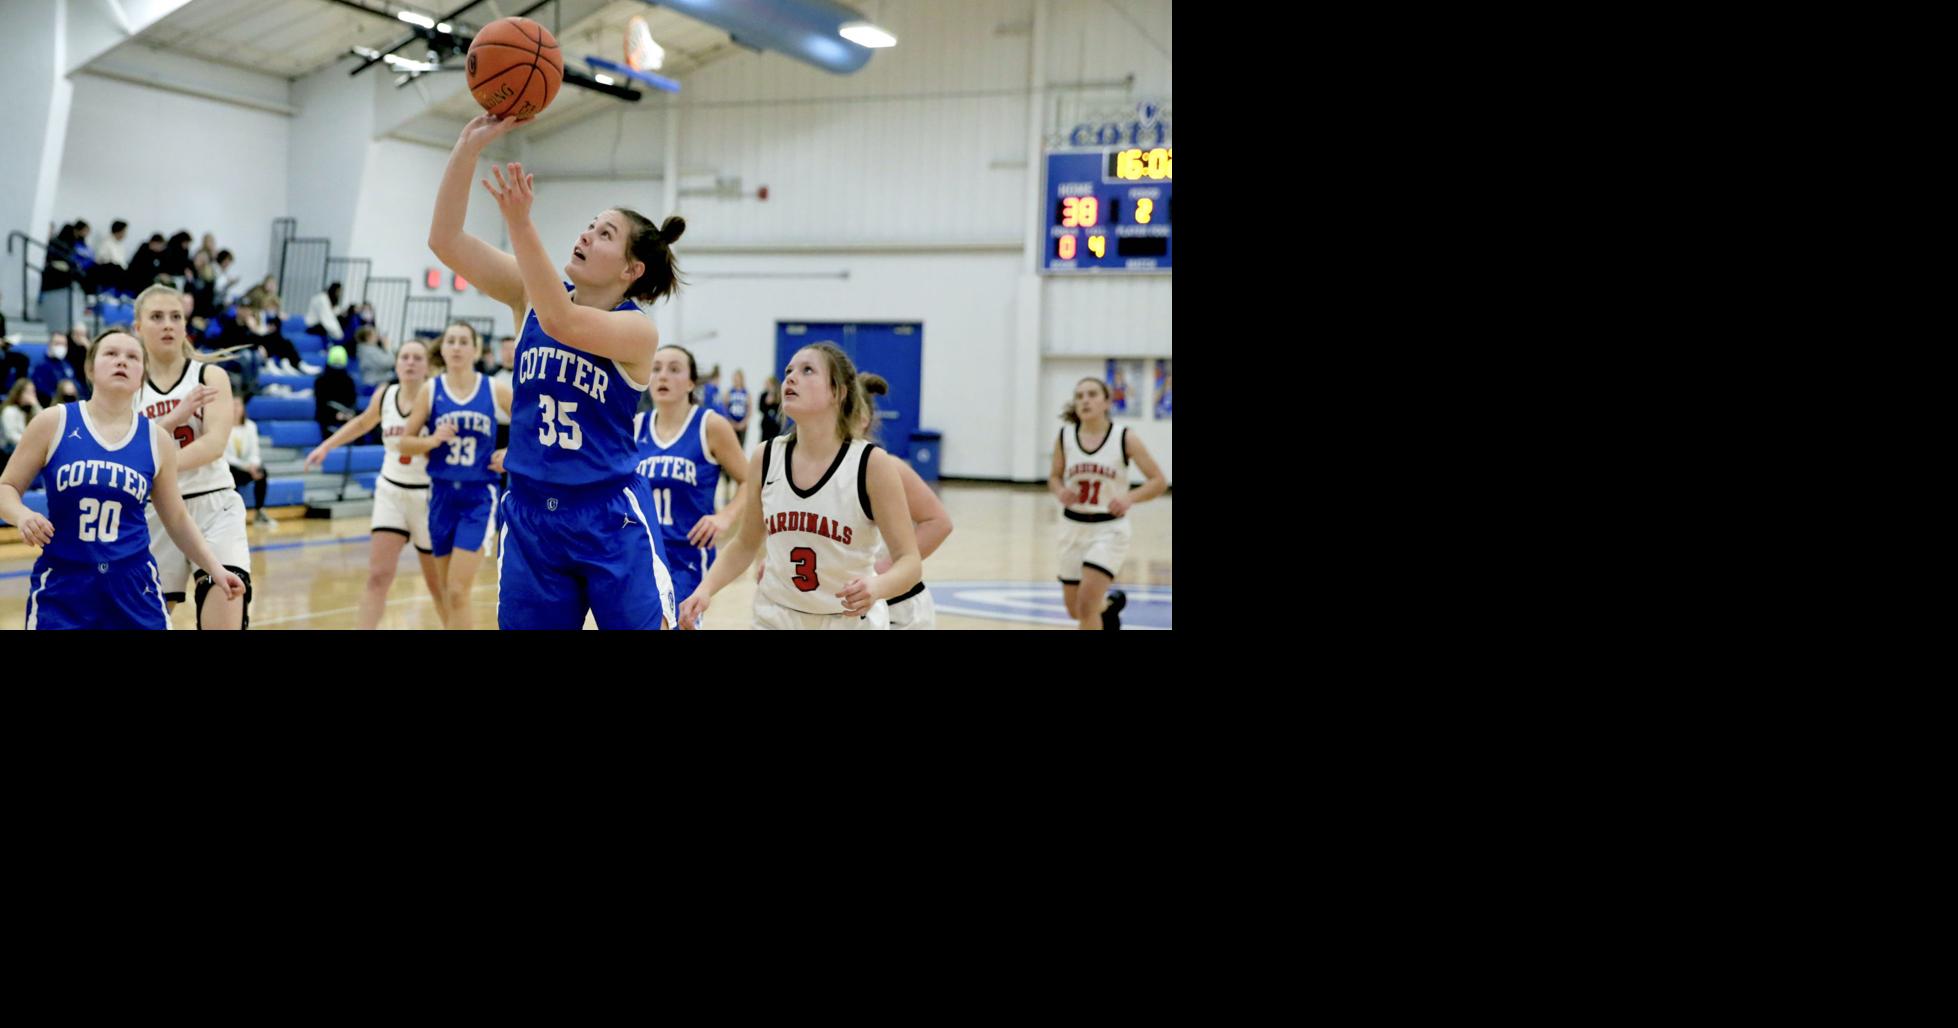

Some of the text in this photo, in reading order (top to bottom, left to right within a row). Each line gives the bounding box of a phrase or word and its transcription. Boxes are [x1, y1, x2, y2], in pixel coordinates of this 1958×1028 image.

[1116, 148, 1171, 180] 16:0
[1062, 196, 1098, 228] 38
[1135, 197, 1153, 225] 2
[1058, 234, 1077, 260] 0
[520, 346, 609, 404] COTTER
[538, 393, 583, 451] 35
[446, 436, 477, 467] 33
[56, 459, 148, 504] COTTER
[636, 455, 698, 487] OTTER
[79, 497, 123, 543] 20
[653, 488, 673, 526] 11
[765, 511, 854, 545] ARDINALS
[790, 546, 820, 592] 3
